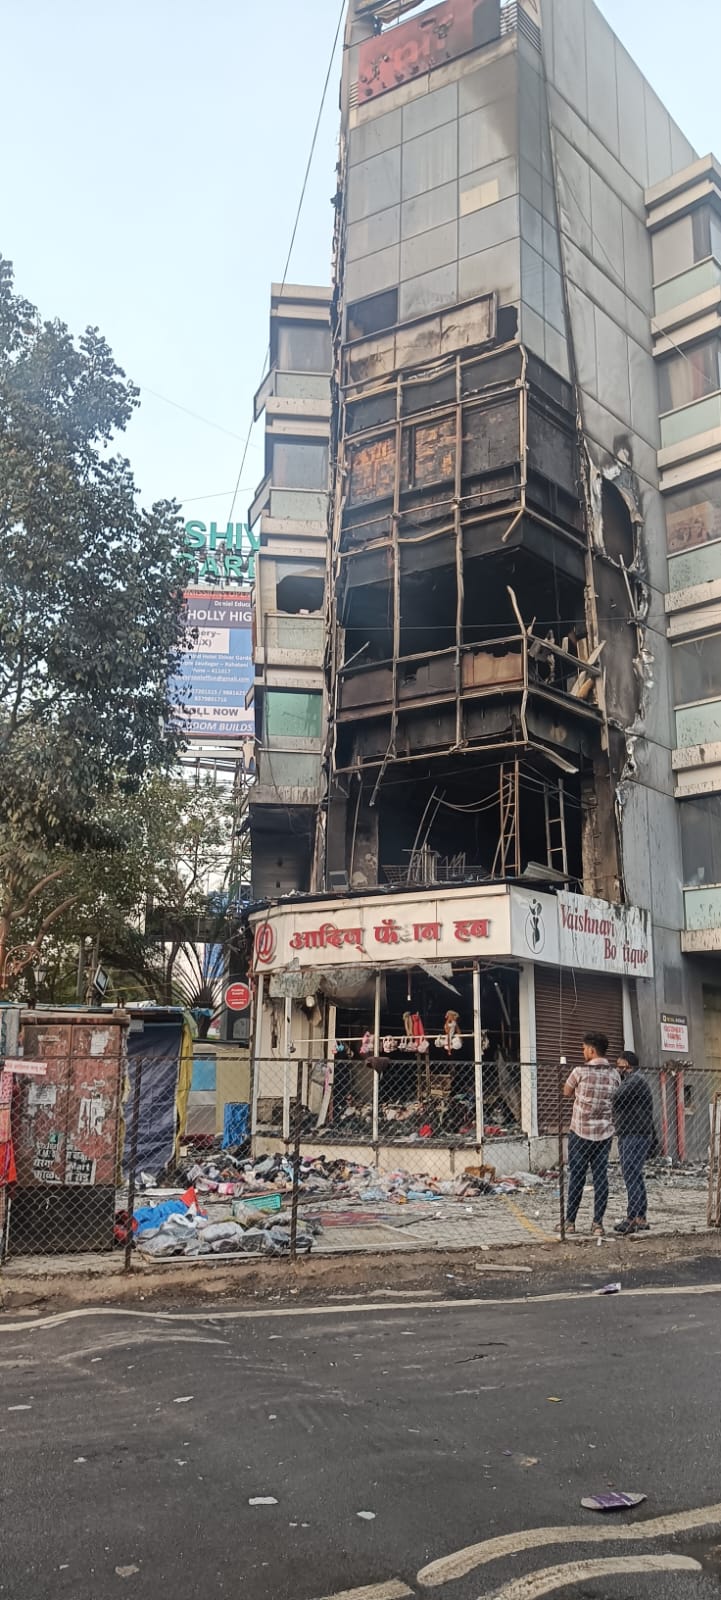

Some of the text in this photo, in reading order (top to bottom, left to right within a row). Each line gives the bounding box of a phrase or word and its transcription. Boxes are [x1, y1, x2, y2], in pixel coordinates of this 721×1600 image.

[187, 609, 226, 621] HOLLY
[213, 708, 239, 717] NOW
[218, 721, 252, 733] BUILDS
[603, 937, 649, 969] Botique
